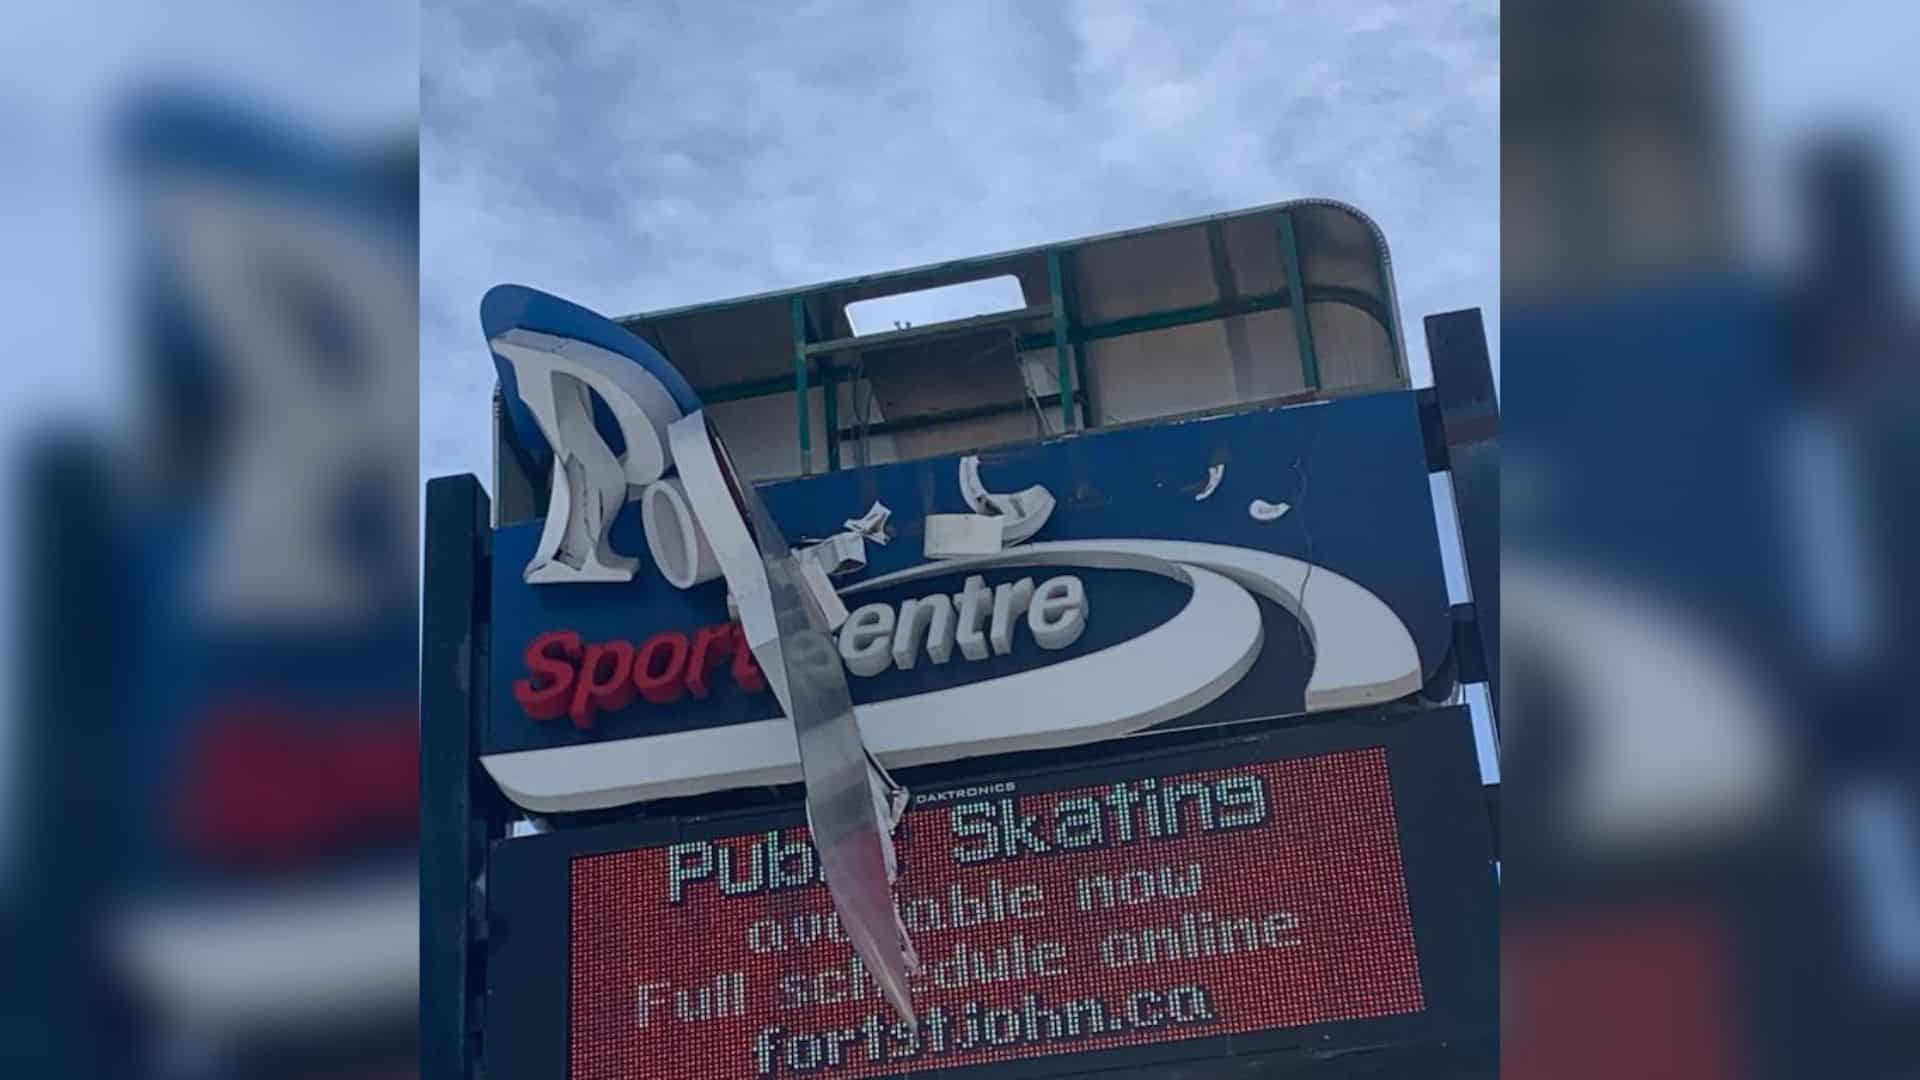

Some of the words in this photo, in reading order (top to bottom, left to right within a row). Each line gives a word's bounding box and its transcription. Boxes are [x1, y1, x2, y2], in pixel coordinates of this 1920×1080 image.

[514, 624, 771, 729] Sport
[833, 575, 1087, 677] entre
[667, 829, 906, 903] Pub
[951, 774, 1268, 864] Skating
[915, 781, 1016, 804] DAKTRONICS
[748, 879, 1046, 954] avable
[1077, 860, 1203, 911] now
[637, 971, 746, 1029] Full
[1102, 909, 1302, 969] online
[752, 983, 1216, 1075] fortstjohn.ca
